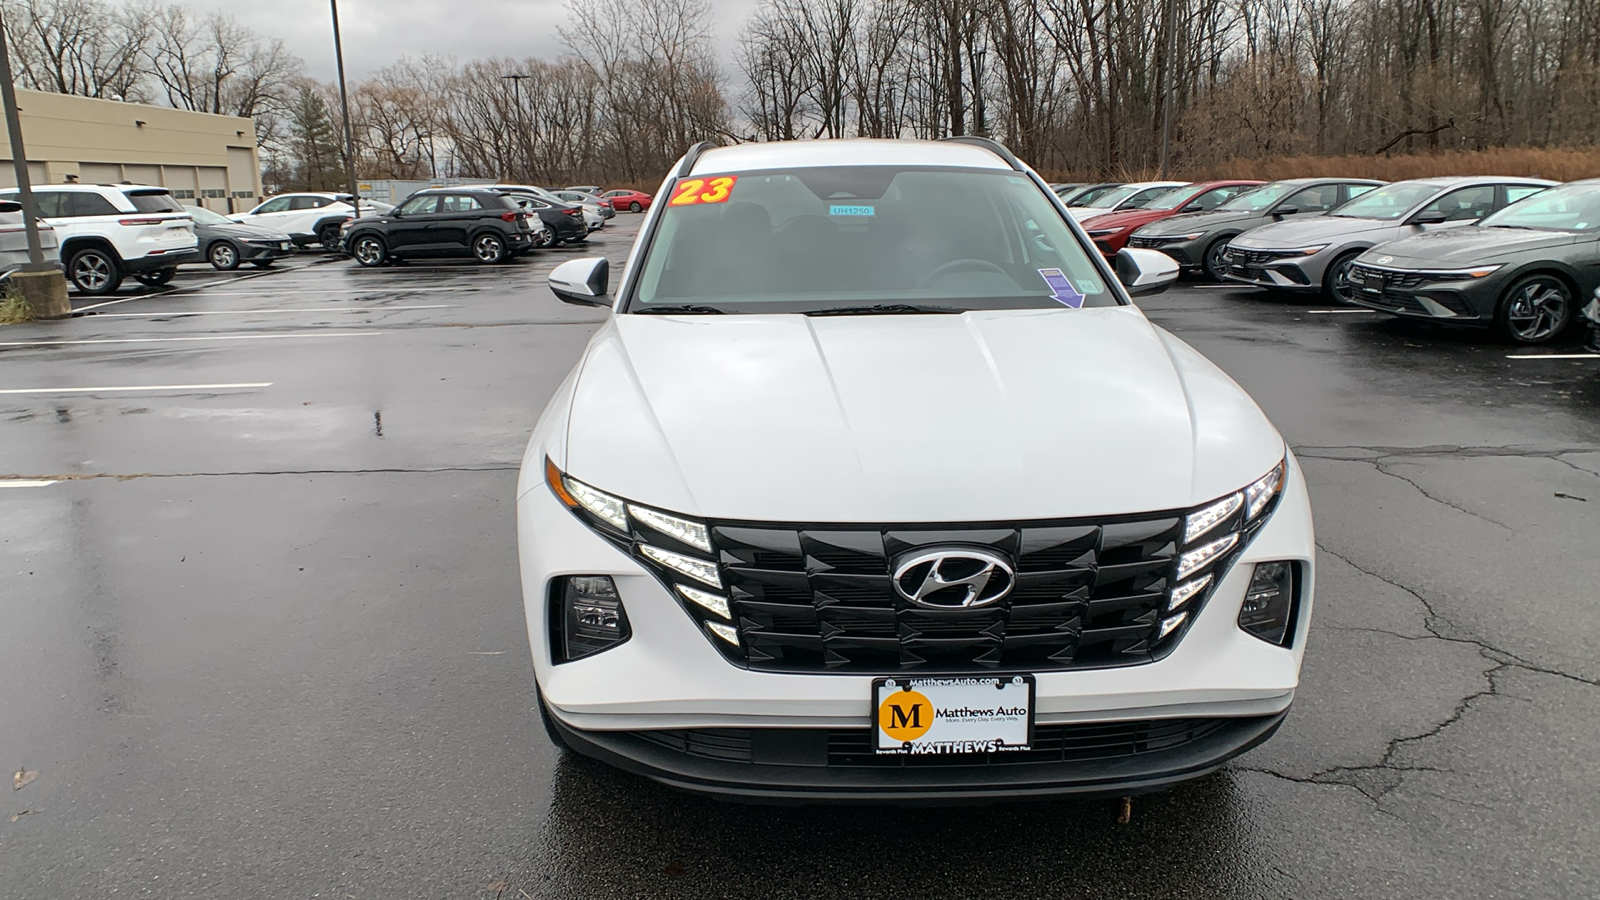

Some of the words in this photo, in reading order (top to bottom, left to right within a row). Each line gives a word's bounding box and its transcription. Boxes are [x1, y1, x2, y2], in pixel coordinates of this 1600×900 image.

[671, 177, 735, 204] 23
[833, 207, 870, 215] UH1250
[909, 677, 1000, 687] MatthewsAuto.com
[887, 703, 924, 729] M
[935, 706, 995, 718] Matthews
[995, 706, 1027, 716] Auto
[910, 741, 997, 755] MATTHEWS
